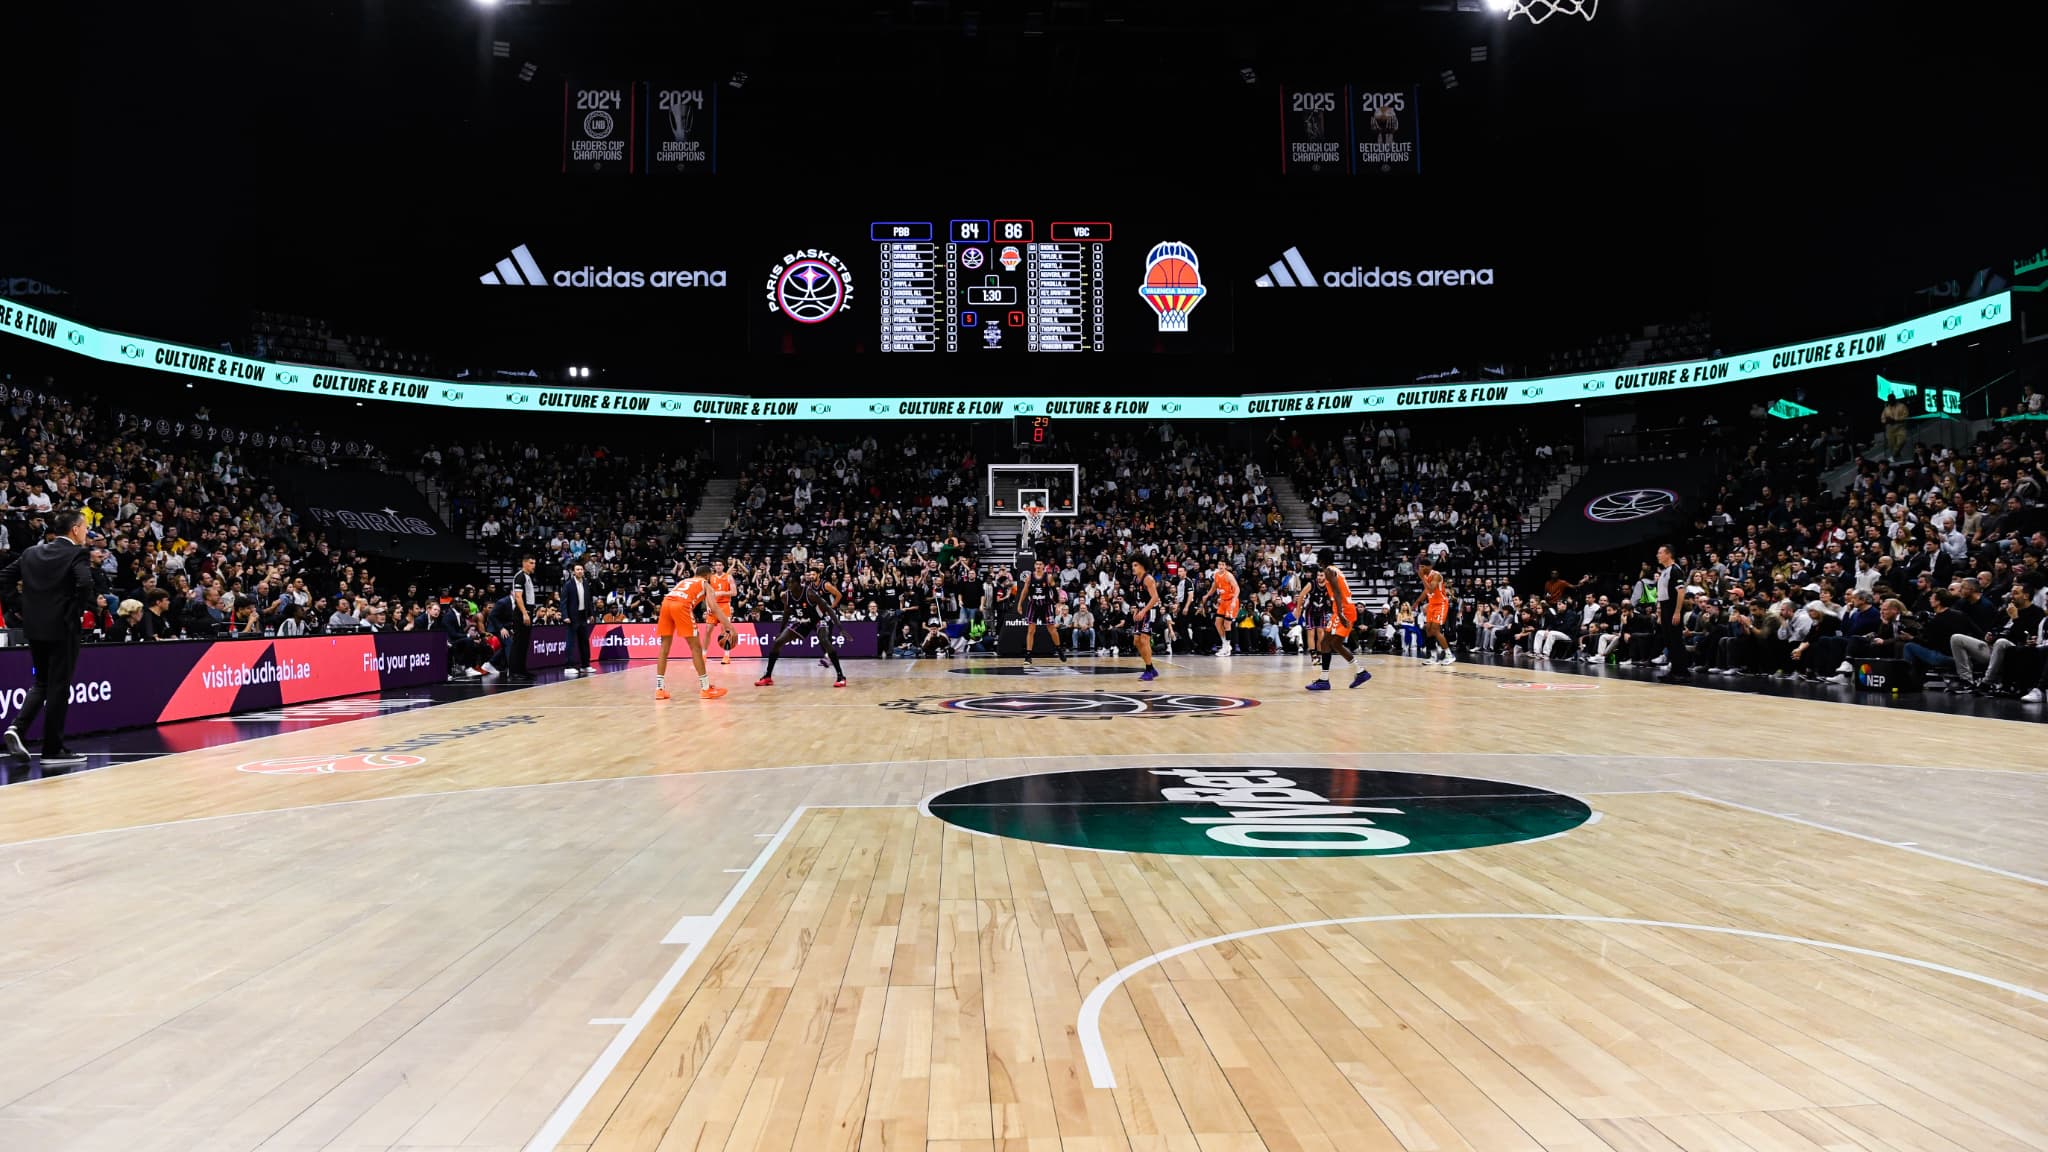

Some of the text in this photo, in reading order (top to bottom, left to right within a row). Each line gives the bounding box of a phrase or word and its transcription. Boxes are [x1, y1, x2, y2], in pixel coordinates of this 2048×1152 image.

[576, 90, 621, 110] 2024
[659, 90, 704, 110] 2024
[1293, 92, 1335, 112] 2025
[1362, 92, 1405, 112] 2025
[572, 140, 625, 151] LEADERS CUP
[663, 141, 700, 152] EUROCUP
[1292, 142, 1339, 153] FRENCH CUP
[1360, 142, 1412, 153] BETCLIC ELITE
[573, 151, 623, 161] CHAMPIONS
[657, 152, 705, 162] CHAMPIONS
[1293, 152, 1339, 162] CHAMPIONS
[1362, 152, 1409, 162] CHAMPIONS
[893, 226, 910, 237] PBB
[961, 223, 979, 239] 84
[1004, 223, 1023, 239] 86
[1073, 226, 1090, 237] VBC
[553, 266, 727, 287] adidas arena
[766, 249, 854, 312] PARIS BASKETBALL
[1323, 266, 1494, 288] adidas arena
[982, 290, 1002, 302] 1:30
[15, 311, 23, 329] &
[26, 314, 58, 340] FLOW
[1772, 333, 1887, 368] CULTURE & FLOW
[155, 348, 265, 382] CULTURE & FLOW
[1615, 363, 1730, 390] CULTURE & FLOW
[313, 374, 429, 399] CULTURE & FLOW
[539, 392, 650, 411] CULTURE & FLOW
[1248, 395, 1353, 413] CULTURE & FLOW
[1397, 387, 1509, 406] CULTURE & FLOW
[693, 400, 798, 416] CULTURE & FLOW
[899, 402, 1003, 415] CULTURE & FLOW
[1046, 401, 1149, 414] CULTURE & FLOW
[1034, 428, 1043, 442] 8
[309, 507, 437, 536] PARIS
[738, 633, 769, 645] Find
[363, 652, 430, 672] Find your pace
[202, 658, 311, 689] visitabudhabi.ae
[1866, 674, 1886, 687] NEP
[1149, 768, 1410, 850] OlyBet
